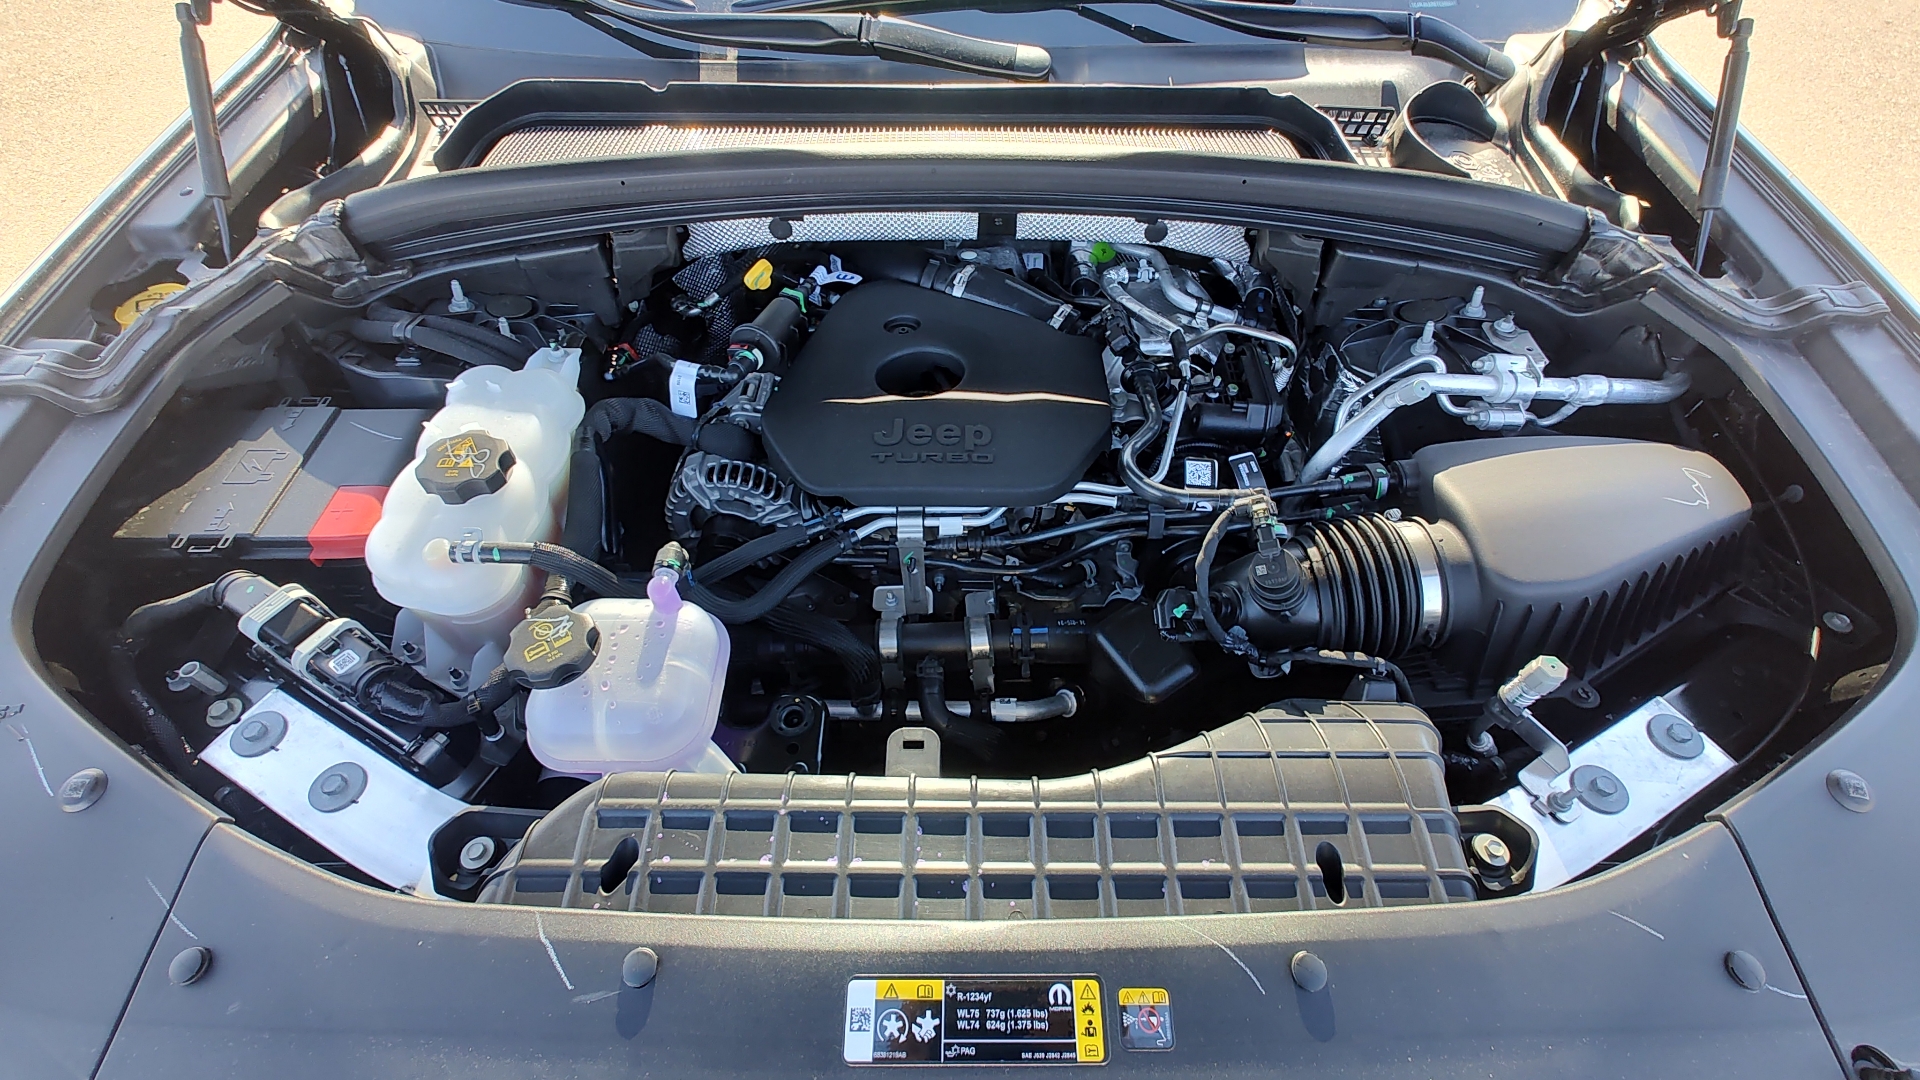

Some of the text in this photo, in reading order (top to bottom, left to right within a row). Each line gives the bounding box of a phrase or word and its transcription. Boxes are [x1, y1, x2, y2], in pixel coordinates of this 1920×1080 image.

[873, 418, 993, 452] Jeep
[870, 452, 994, 464] TURBO
[957, 992, 992, 1003] R-1234yf
[957, 1009, 1048, 1020] WL75 737g (1.625 lbs)
[957, 1020, 1049, 1032] WL74 624g (1.375 lbs)
[960, 1047, 976, 1056] PAG
